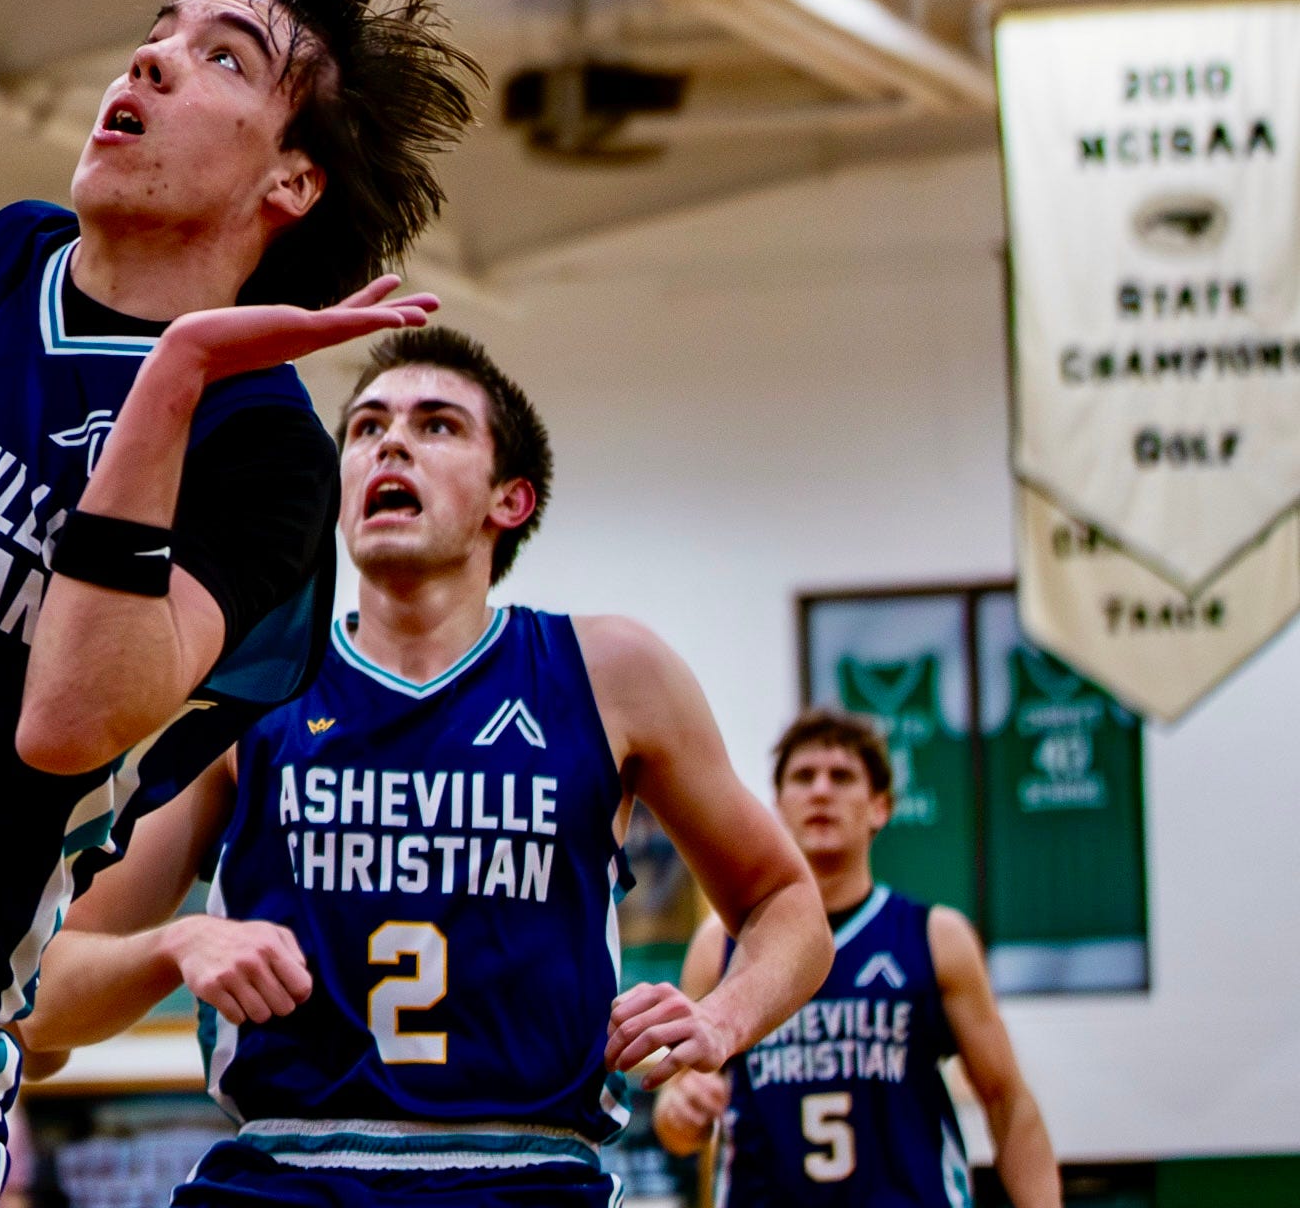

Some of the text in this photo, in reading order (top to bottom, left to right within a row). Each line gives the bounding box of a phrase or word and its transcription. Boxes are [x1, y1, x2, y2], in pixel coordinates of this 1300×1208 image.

[1122, 62, 1233, 102] 2010
[279, 764, 558, 836] ASHEVILLE
[367, 920, 448, 1064] 2
[746, 1039, 909, 1090] CHRISTIAN
[801, 1091, 857, 1183] 5
